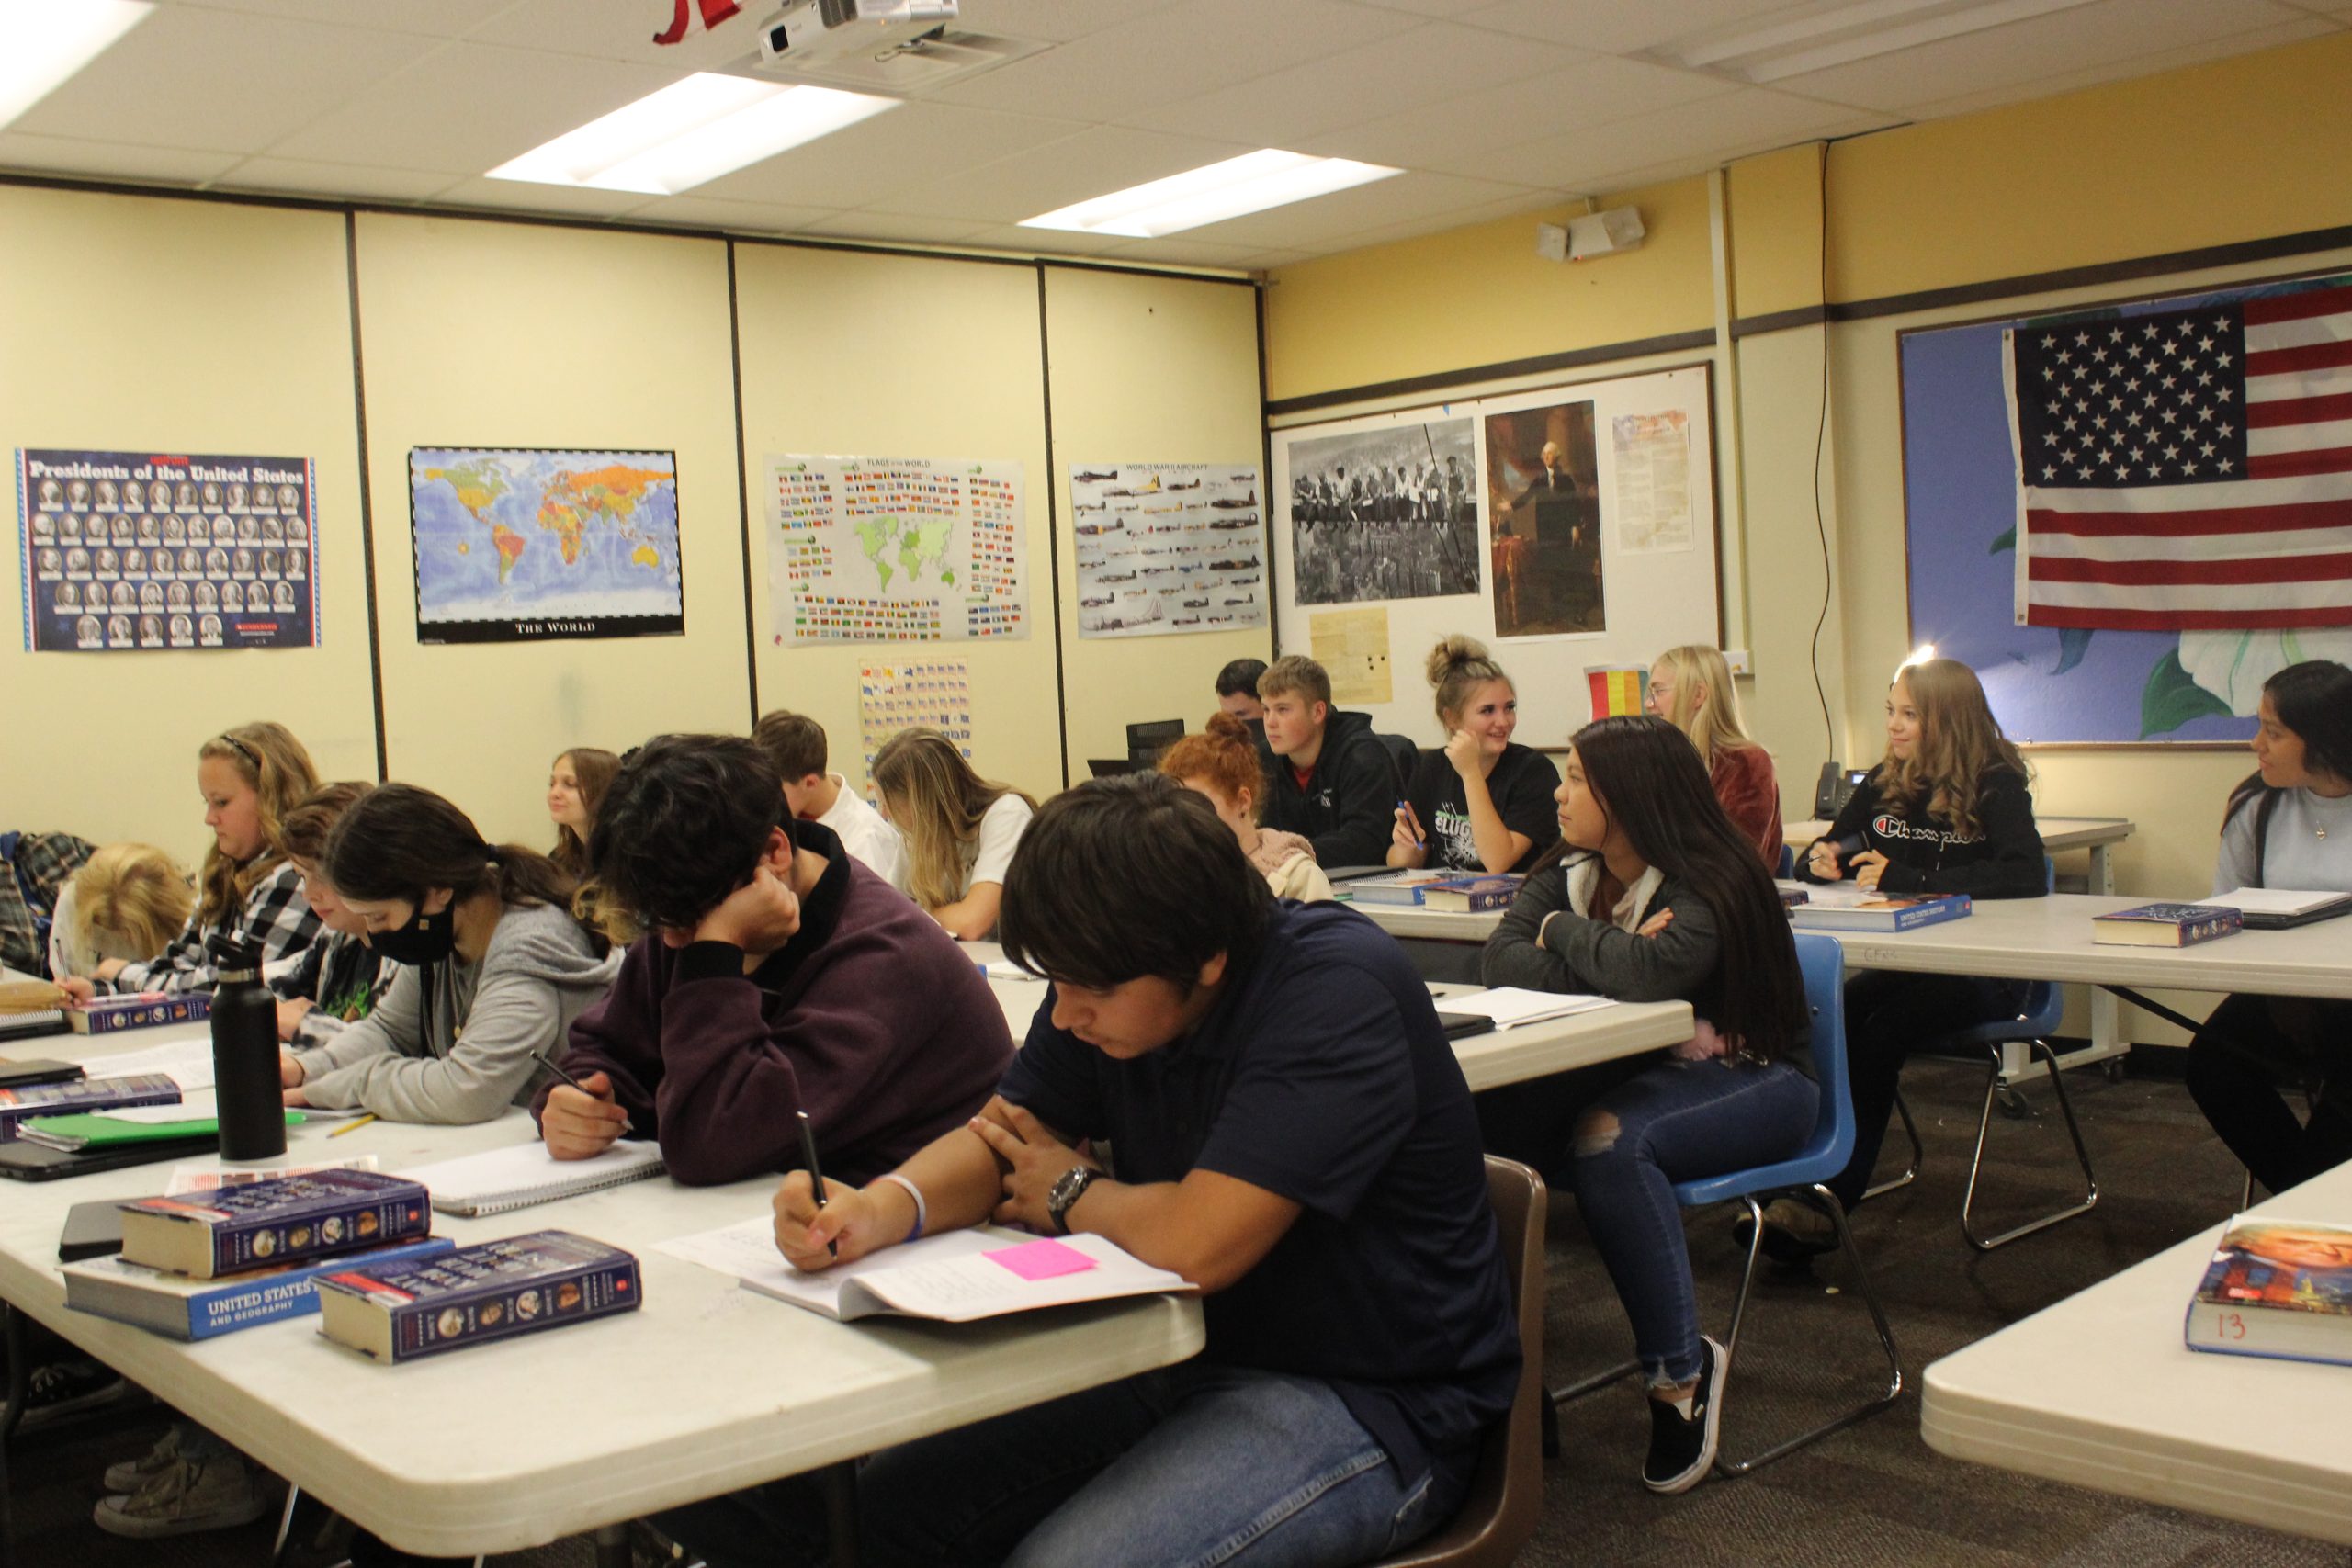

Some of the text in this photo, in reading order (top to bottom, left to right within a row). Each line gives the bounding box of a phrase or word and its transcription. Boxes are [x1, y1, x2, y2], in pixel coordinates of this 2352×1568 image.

[29, 460, 304, 485] Presidents of the United States
[904, 459, 930, 468] WORLD
[1125, 463, 1152, 471] WORLD
[1153, 463, 1170, 471] WAR
[1176, 463, 1208, 471] AIRCRAFT
[515, 622, 595, 634] THE WORLD
[208, 1292, 262, 1316] UNITED
[264, 1280, 311, 1303] STATES
[209, 1301, 293, 1328] AND GEOGRAPHY
[2219, 1314, 2246, 1340] 13
